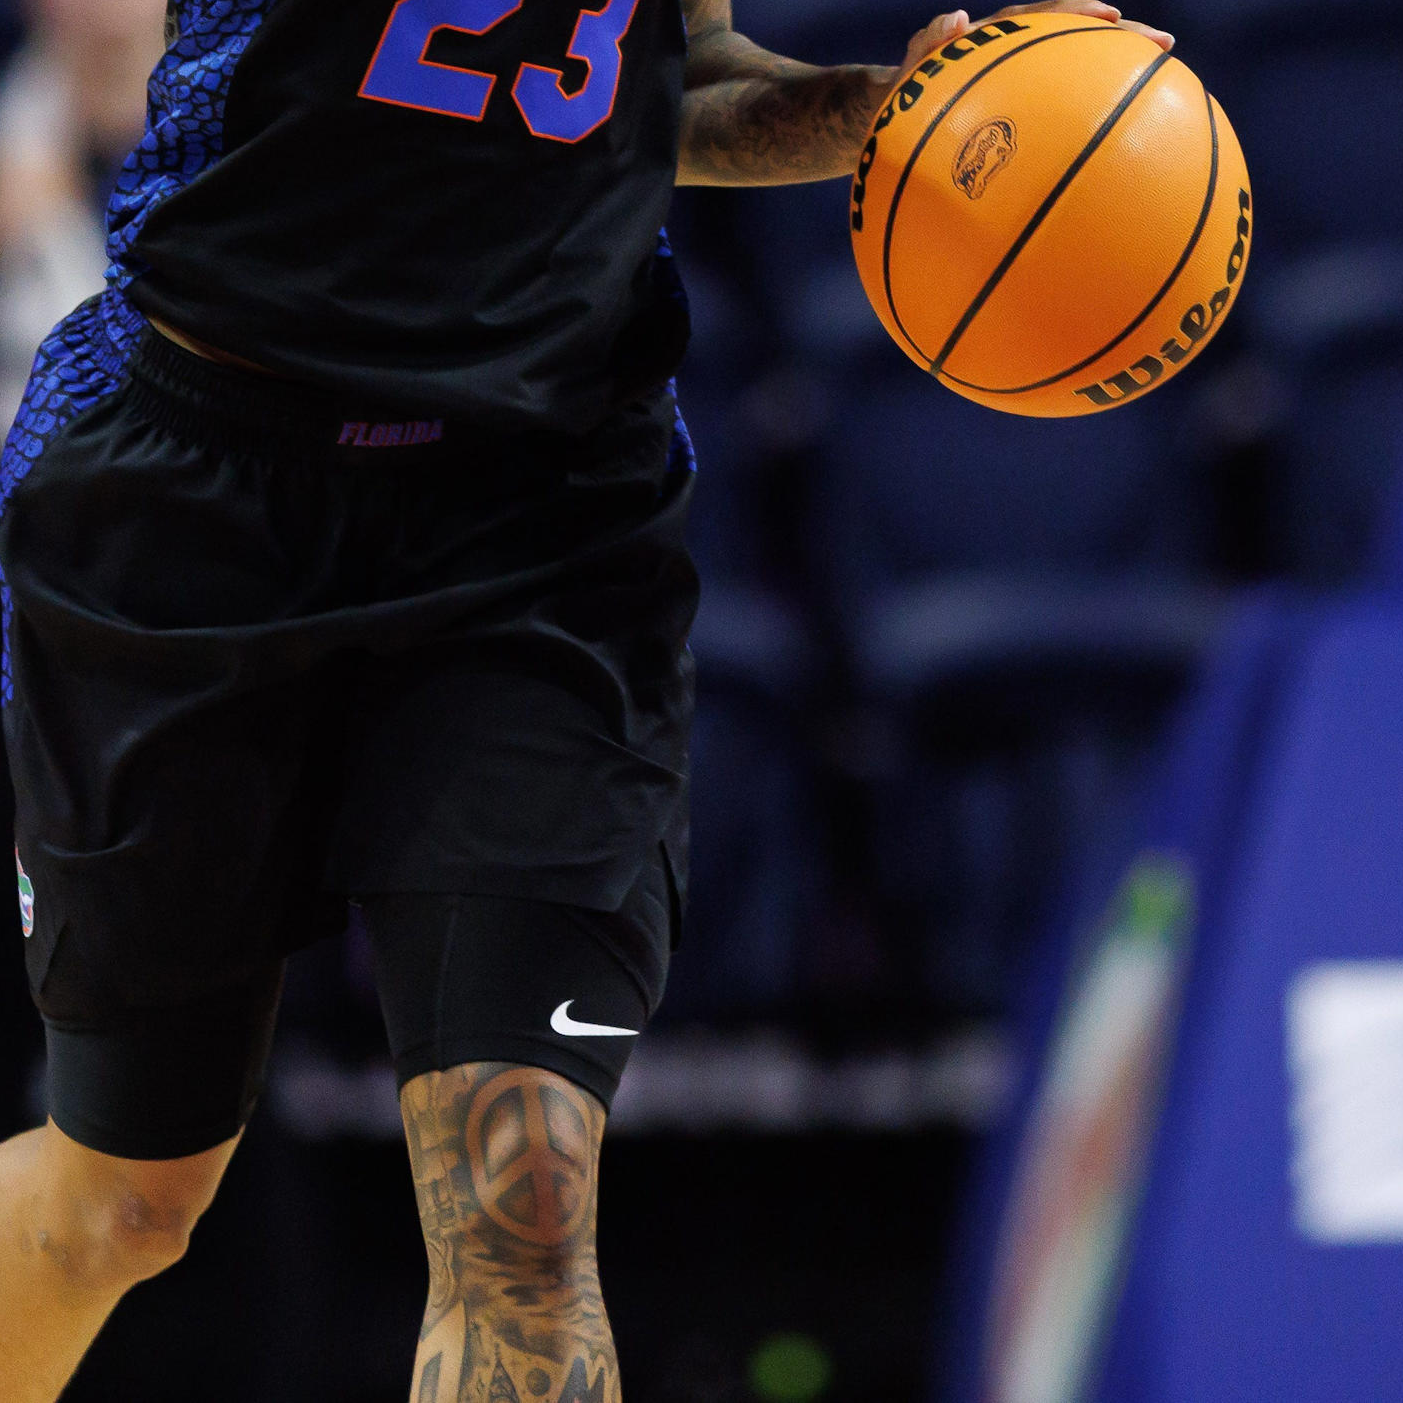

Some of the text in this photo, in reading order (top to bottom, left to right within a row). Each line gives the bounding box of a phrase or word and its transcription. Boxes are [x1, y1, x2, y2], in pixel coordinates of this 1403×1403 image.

[851, 18, 1031, 233] Wilson
[1072, 187, 1251, 406] Wilson
[335, 418, 445, 448] FLORIDA
